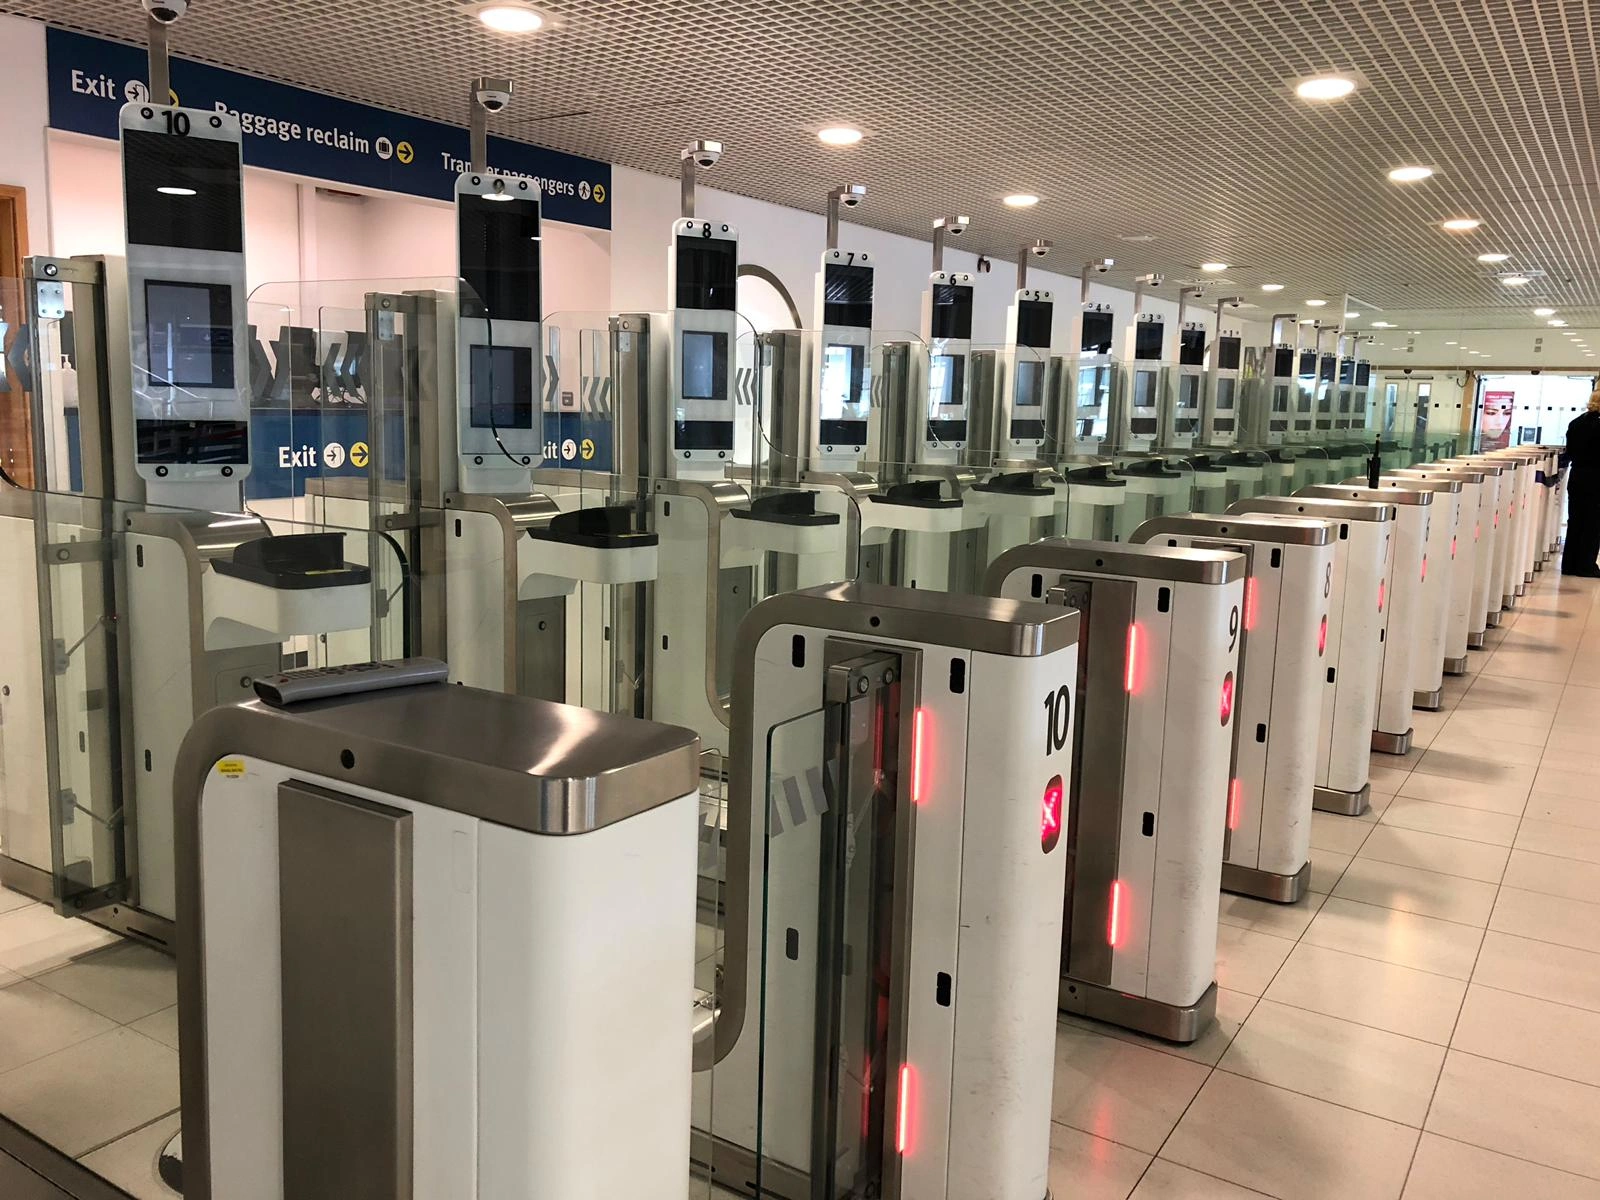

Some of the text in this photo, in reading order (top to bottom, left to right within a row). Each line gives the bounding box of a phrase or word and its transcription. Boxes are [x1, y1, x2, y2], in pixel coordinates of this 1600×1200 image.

[71, 69, 116, 100] Exit
[161, 110, 190, 137] 10
[306, 126, 370, 154] reclaim
[702, 222, 712, 239] 8
[847, 252, 855, 267] 7
[949, 273, 957, 286] 6
[1034, 290, 1040, 302] 5
[1095, 303, 1102, 313] 4
[1148, 313, 1154, 323] 3
[1190, 322, 1196, 331] 2
[278, 444, 317, 468] Exit
[1323, 561, 1332, 599] 8
[1228, 604, 1239, 654] 9
[1043, 684, 1071, 757] 10
